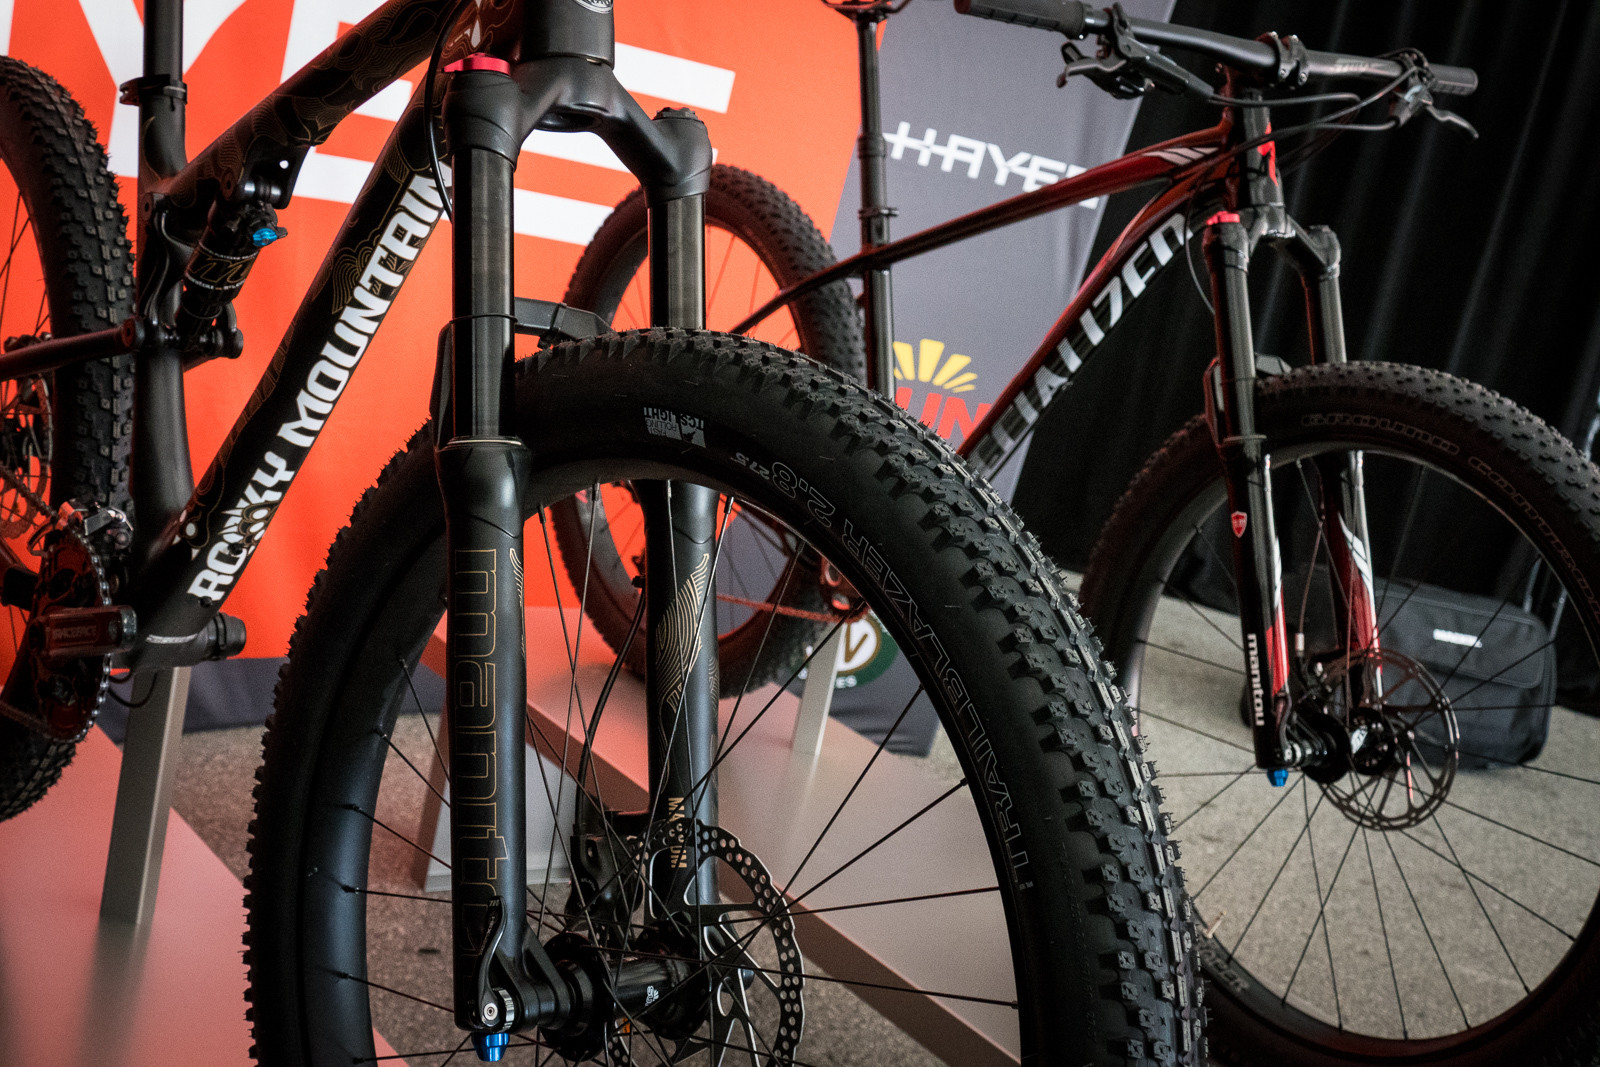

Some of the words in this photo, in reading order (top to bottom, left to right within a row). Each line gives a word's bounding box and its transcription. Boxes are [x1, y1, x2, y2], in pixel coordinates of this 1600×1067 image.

[276, 160, 453, 448] MOUNTAIN
[1301, 412, 1460, 457] GROUND
[771, 461, 836, 528] 2.8
[843, 518, 1029, 883] TRAILBLAZER
[1247, 633, 1265, 727] manitou
[668, 797, 687, 869] MAUM
